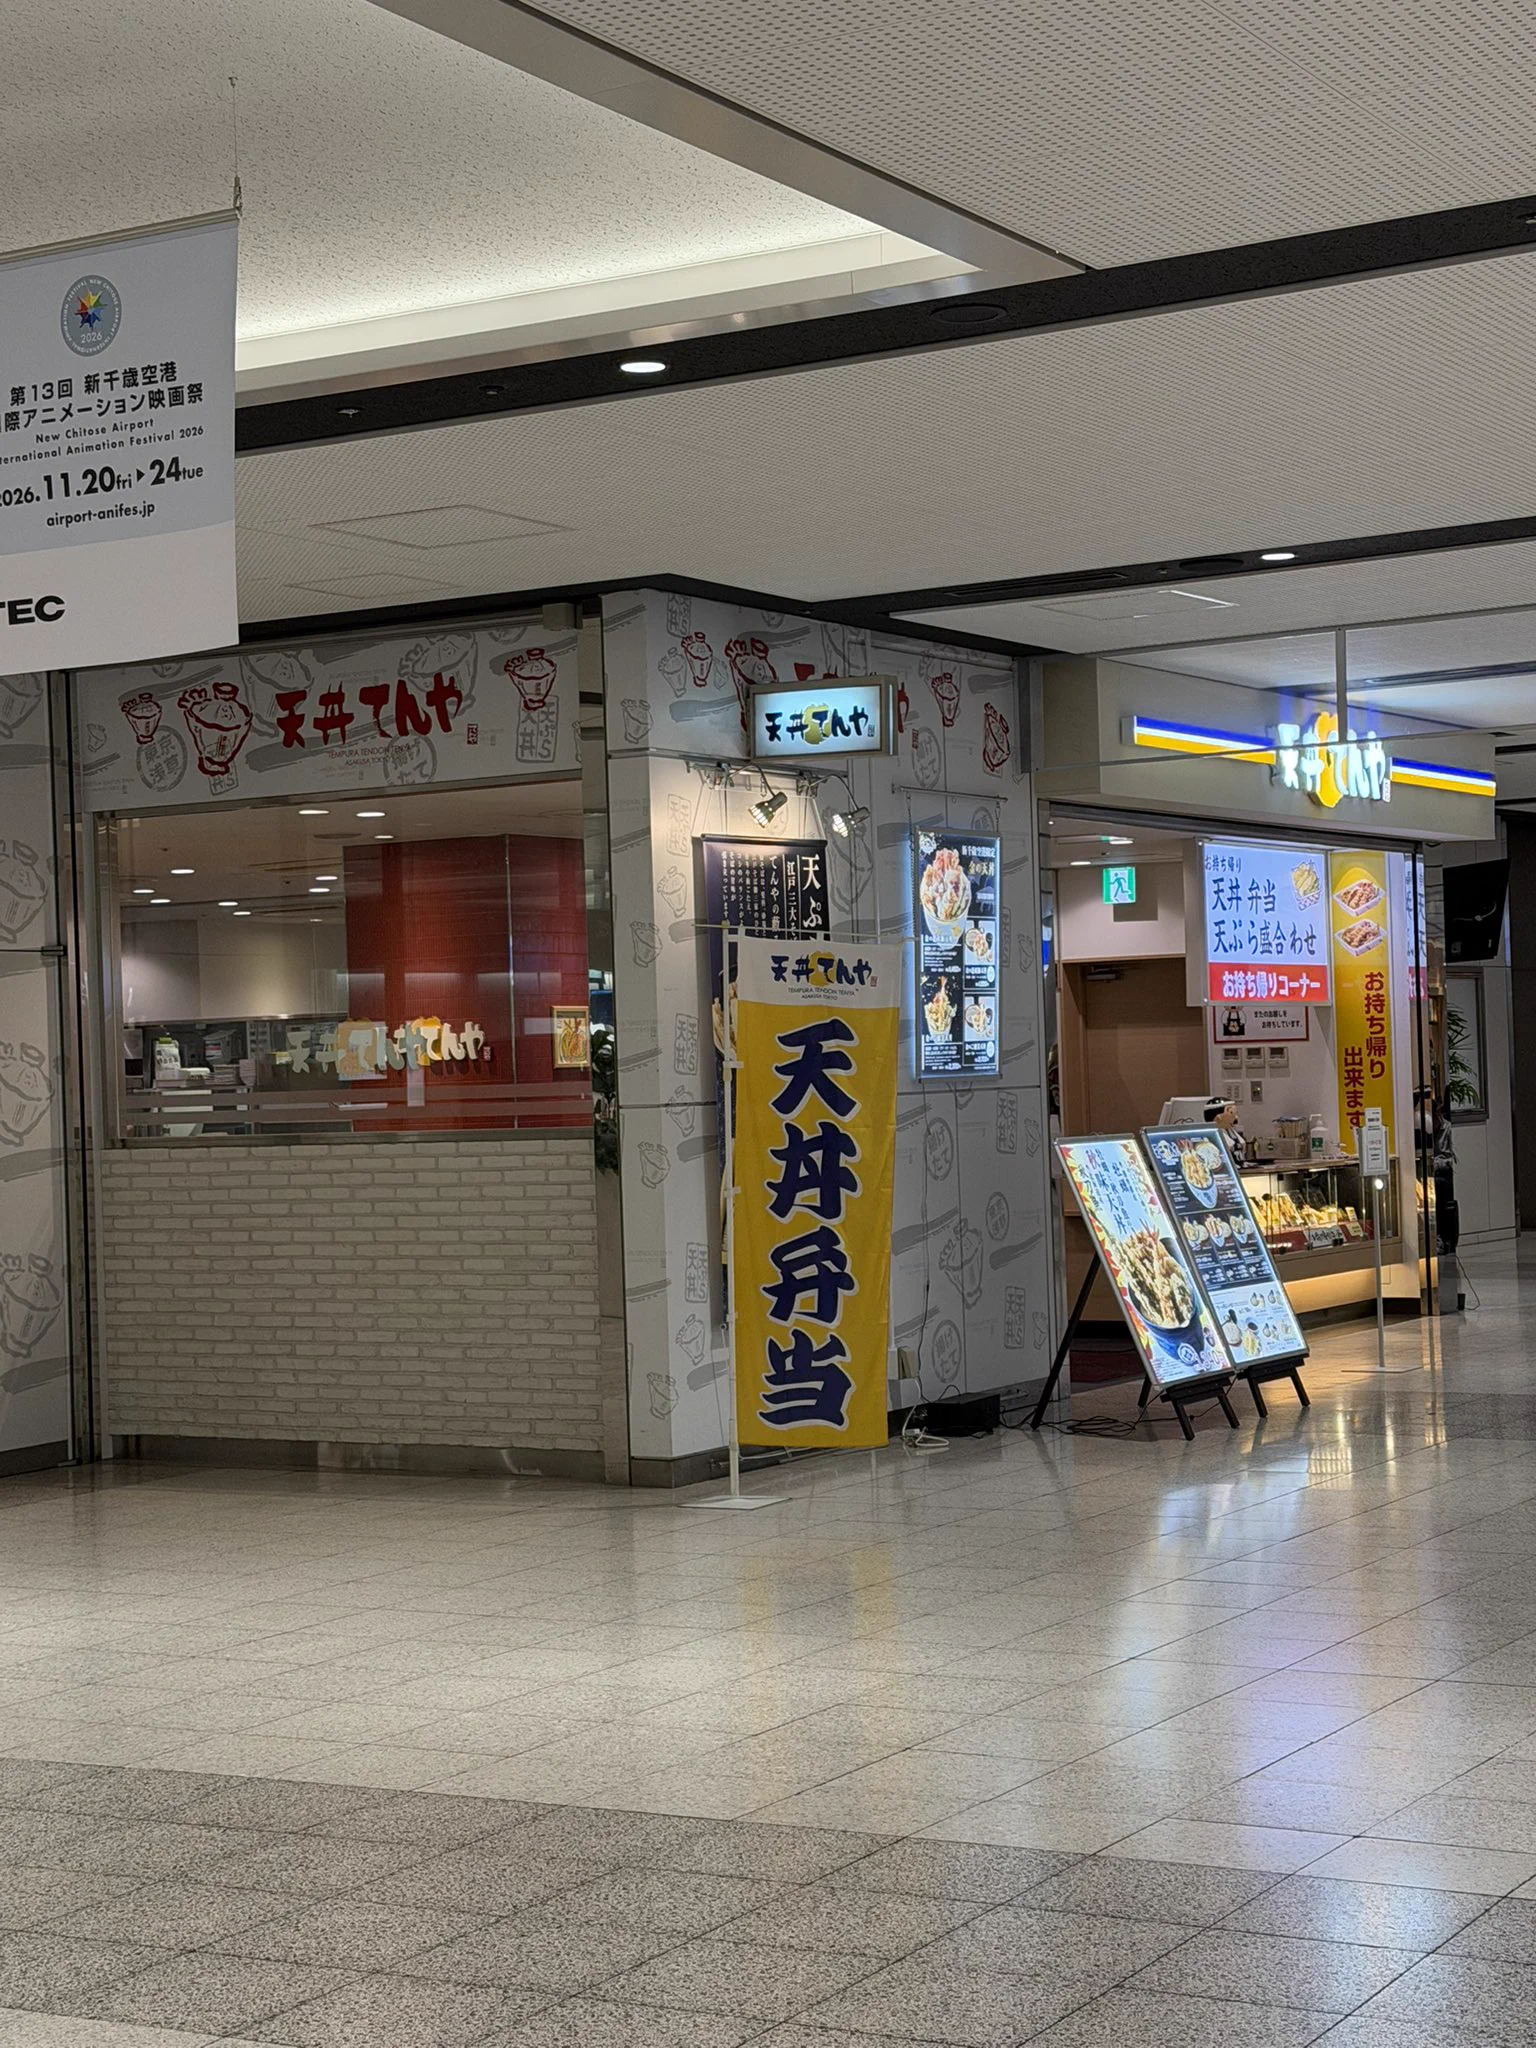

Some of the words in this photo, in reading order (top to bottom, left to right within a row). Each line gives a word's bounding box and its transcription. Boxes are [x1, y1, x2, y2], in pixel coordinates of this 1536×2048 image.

[80, 332, 102, 343] 2026
[10, 378, 73, 407] 第13回
[84, 361, 177, 395] 新千歳空港
[0, 382, 203, 433] 際アニメーション映画祭
[36, 433, 60, 444] New
[65, 426, 106, 439] Chitose
[112, 418, 154, 433] Airport
[67, 440, 124, 455] Animation
[130, 430, 174, 446] Festival
[179, 426, 204, 439] 2026
[46, 501, 155, 528] airport-anifes.jp
[765, 705, 869, 742] 天丼てんや
[1205, 855, 1242, 873] お持ち帰り
[786, 861, 798, 940] 江戸三大そ
[801, 853, 822, 940] 天ぷ
[770, 954, 873, 986] 天丼てんや
[1222, 970, 1321, 998] お持ち帰りコーナー
[1364, 971, 1388, 1080] お持ち帰り
[1343, 1046, 1365, 1130] 出来ます
[758, 1018, 859, 1428] 天丼弁当
